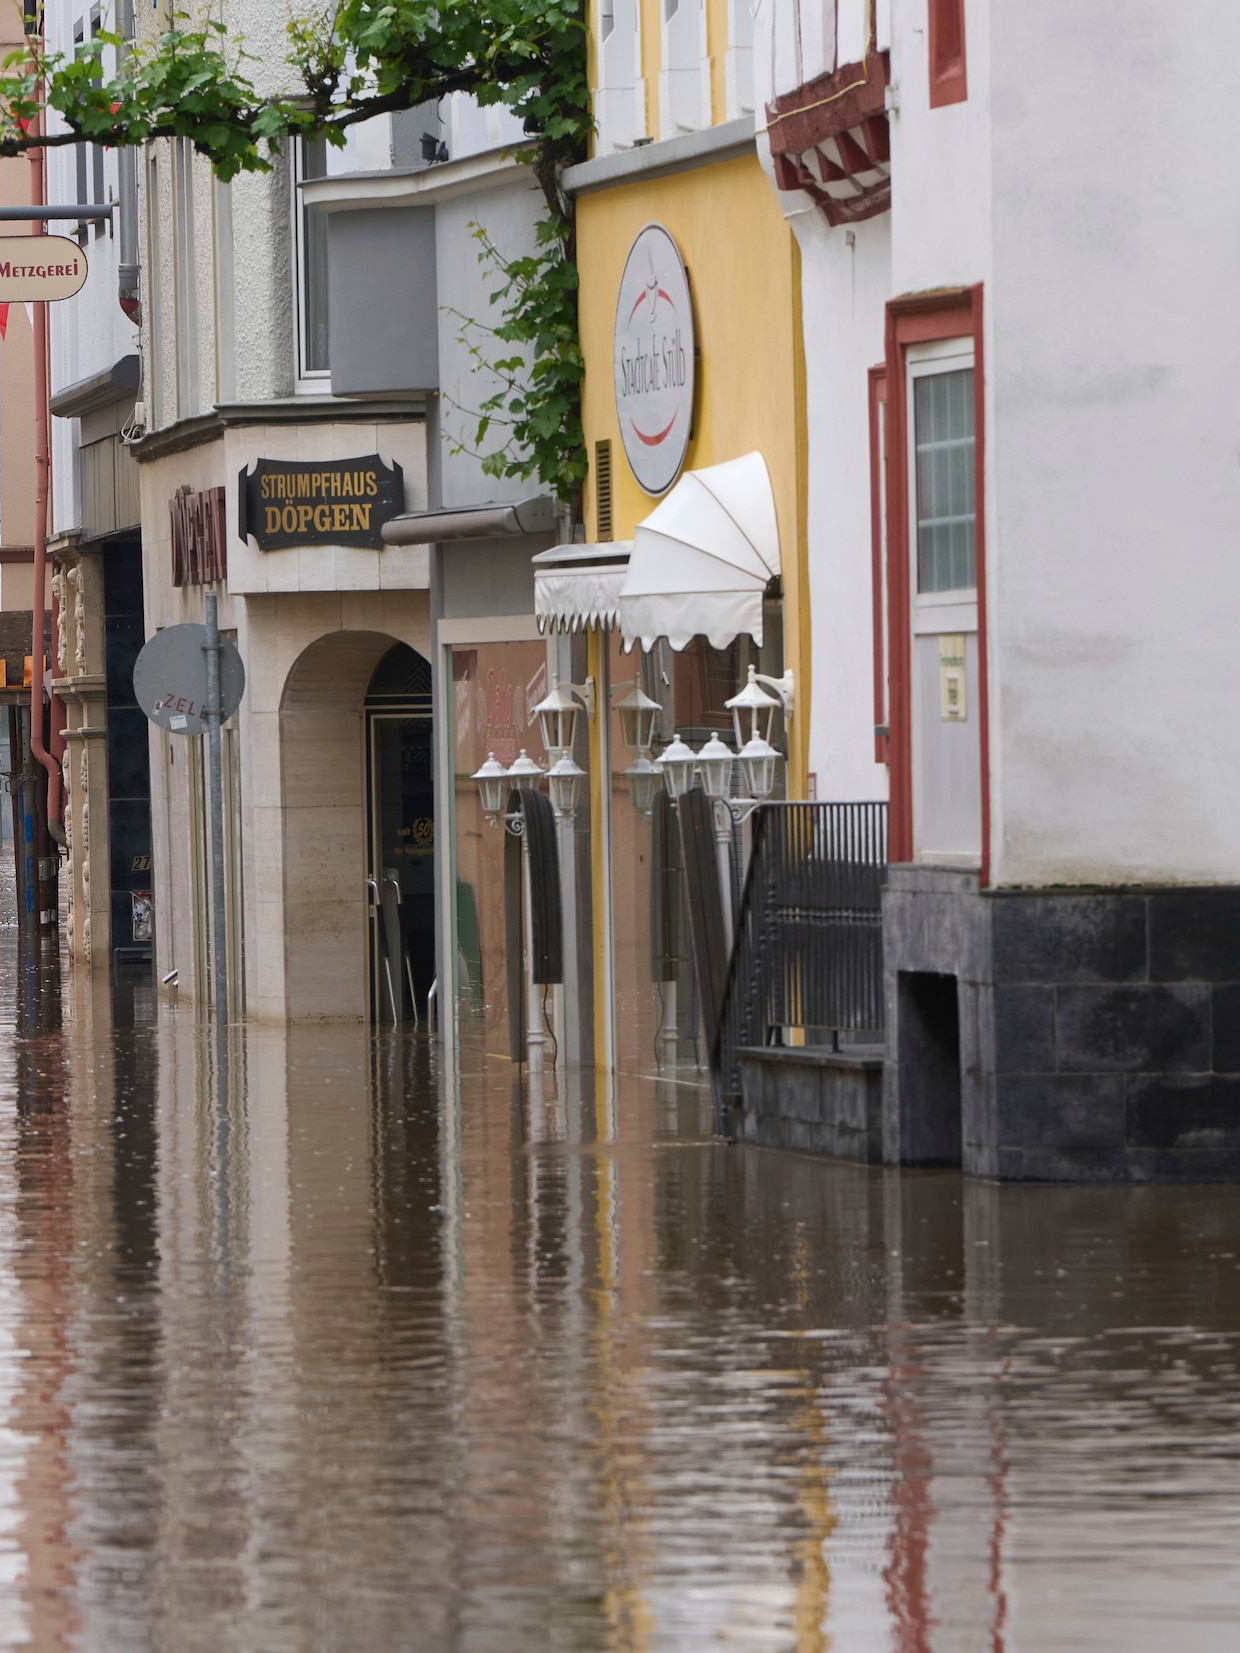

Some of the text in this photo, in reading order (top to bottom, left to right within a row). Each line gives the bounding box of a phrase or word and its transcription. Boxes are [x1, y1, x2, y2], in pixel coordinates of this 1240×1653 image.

[260, 471, 378, 499] STRUMPFHAUS
[265, 499, 372, 533] DÖPGEN
[134, 857, 150, 869] 27
